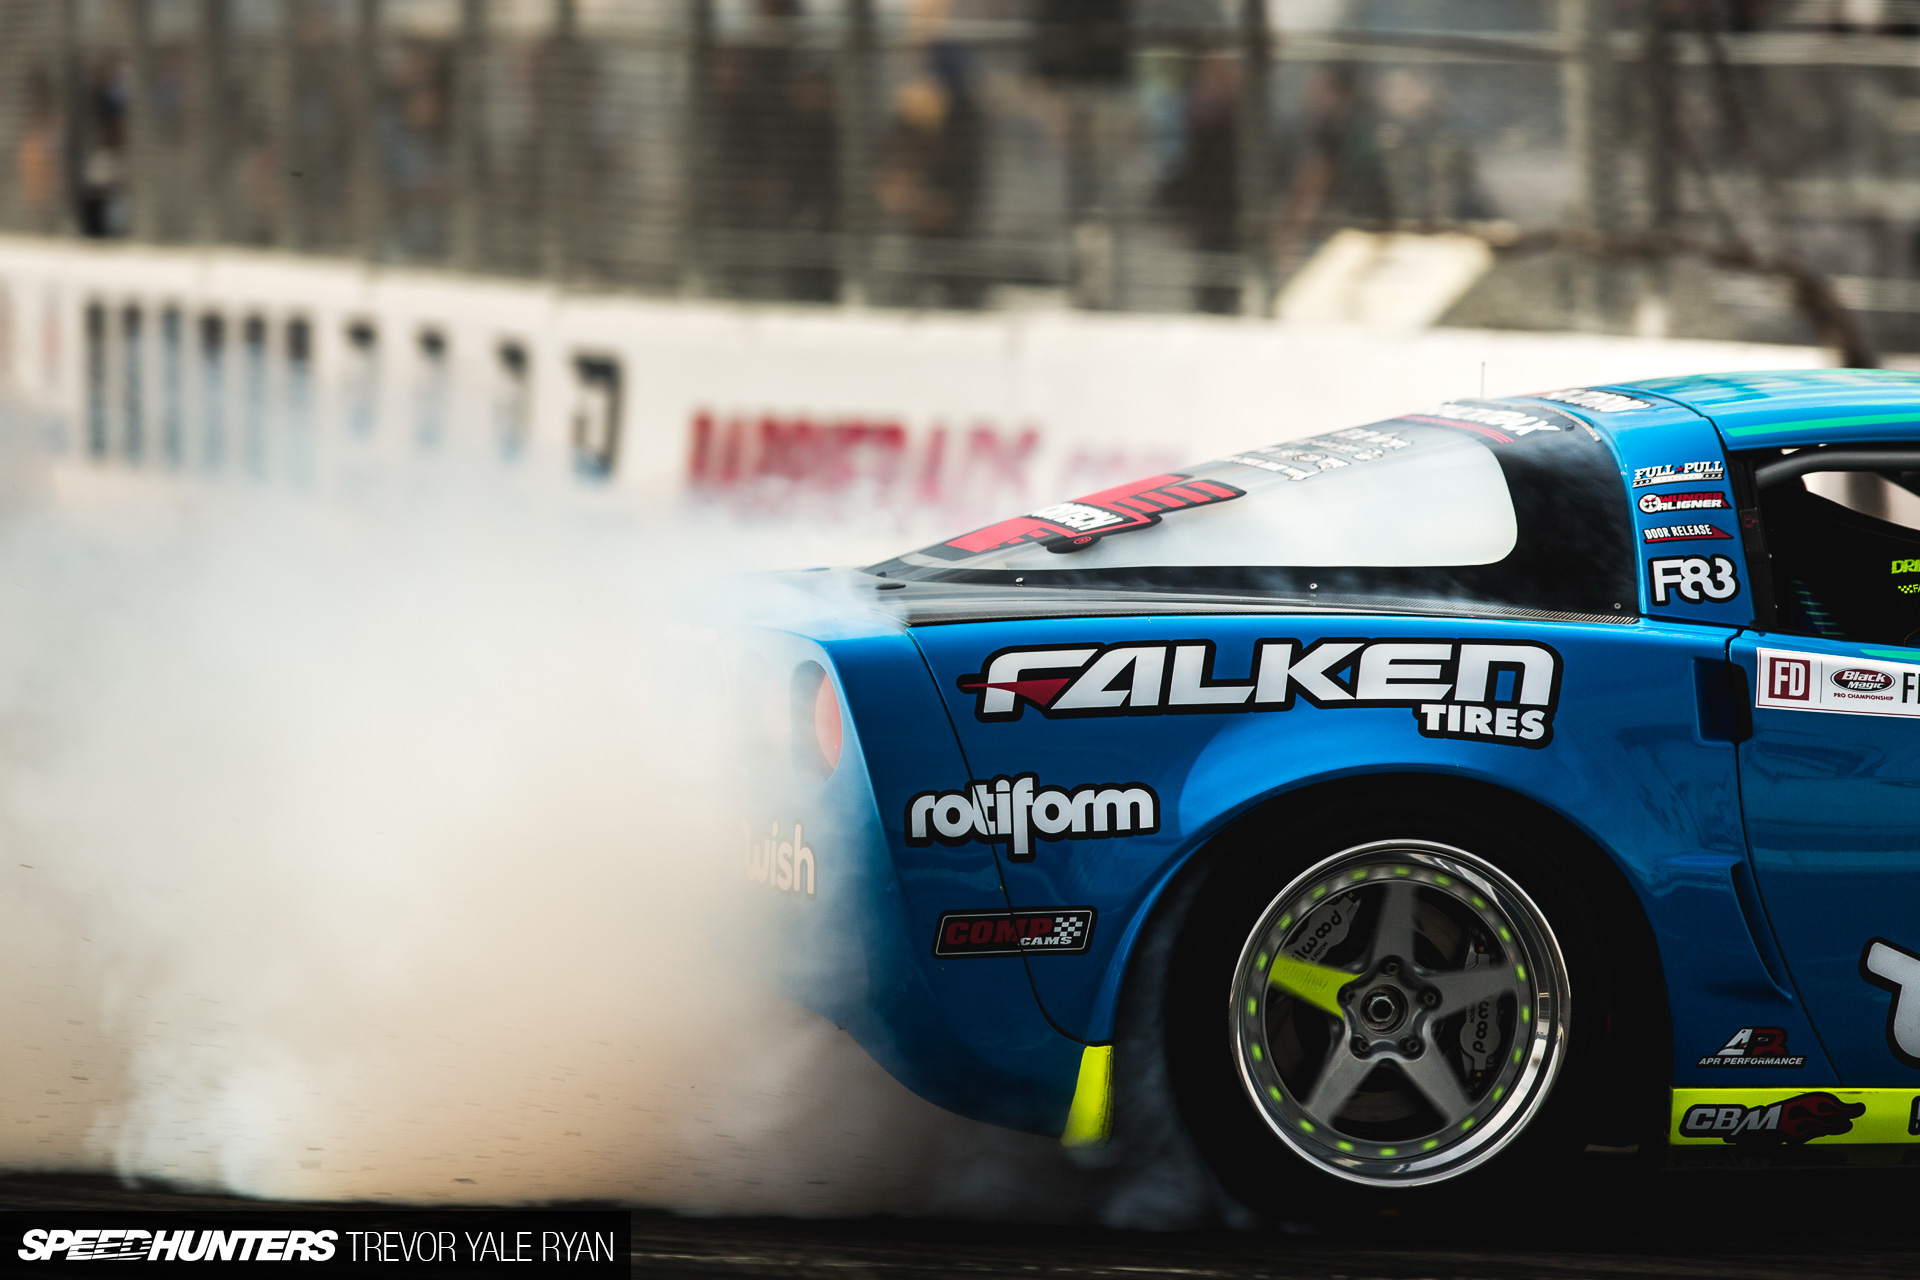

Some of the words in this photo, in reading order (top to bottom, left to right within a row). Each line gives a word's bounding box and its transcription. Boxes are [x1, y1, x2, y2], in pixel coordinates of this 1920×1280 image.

[1634, 464, 1674, 480] FULL
[1684, 461, 1723, 474] PULL
[1657, 499, 1721, 511] ALIGNER
[1660, 492, 1722, 502] WUNDER
[1644, 527, 1670, 540] DOOR
[1671, 524, 1712, 537] RELEASE
[1653, 557, 1736, 602] F83
[962, 643, 1555, 714] FALKEN
[1773, 660, 1807, 696] FD
[1841, 670, 1886, 682] Black
[1847, 681, 1885, 690] Magic
[1847, 693, 1894, 701] CHAMPIONSHIP
[1420, 703, 1545, 740] TIRES
[911, 777, 1155, 855] rotiform
[742, 816, 815, 895] wish
[945, 918, 1053, 945] COMP
[1020, 936, 1073, 946] CAMS
[1699, 1057, 1721, 1065] APR
[1723, 1057, 1804, 1065] PERFORMANCE
[1685, 1105, 1782, 1136] CBM
